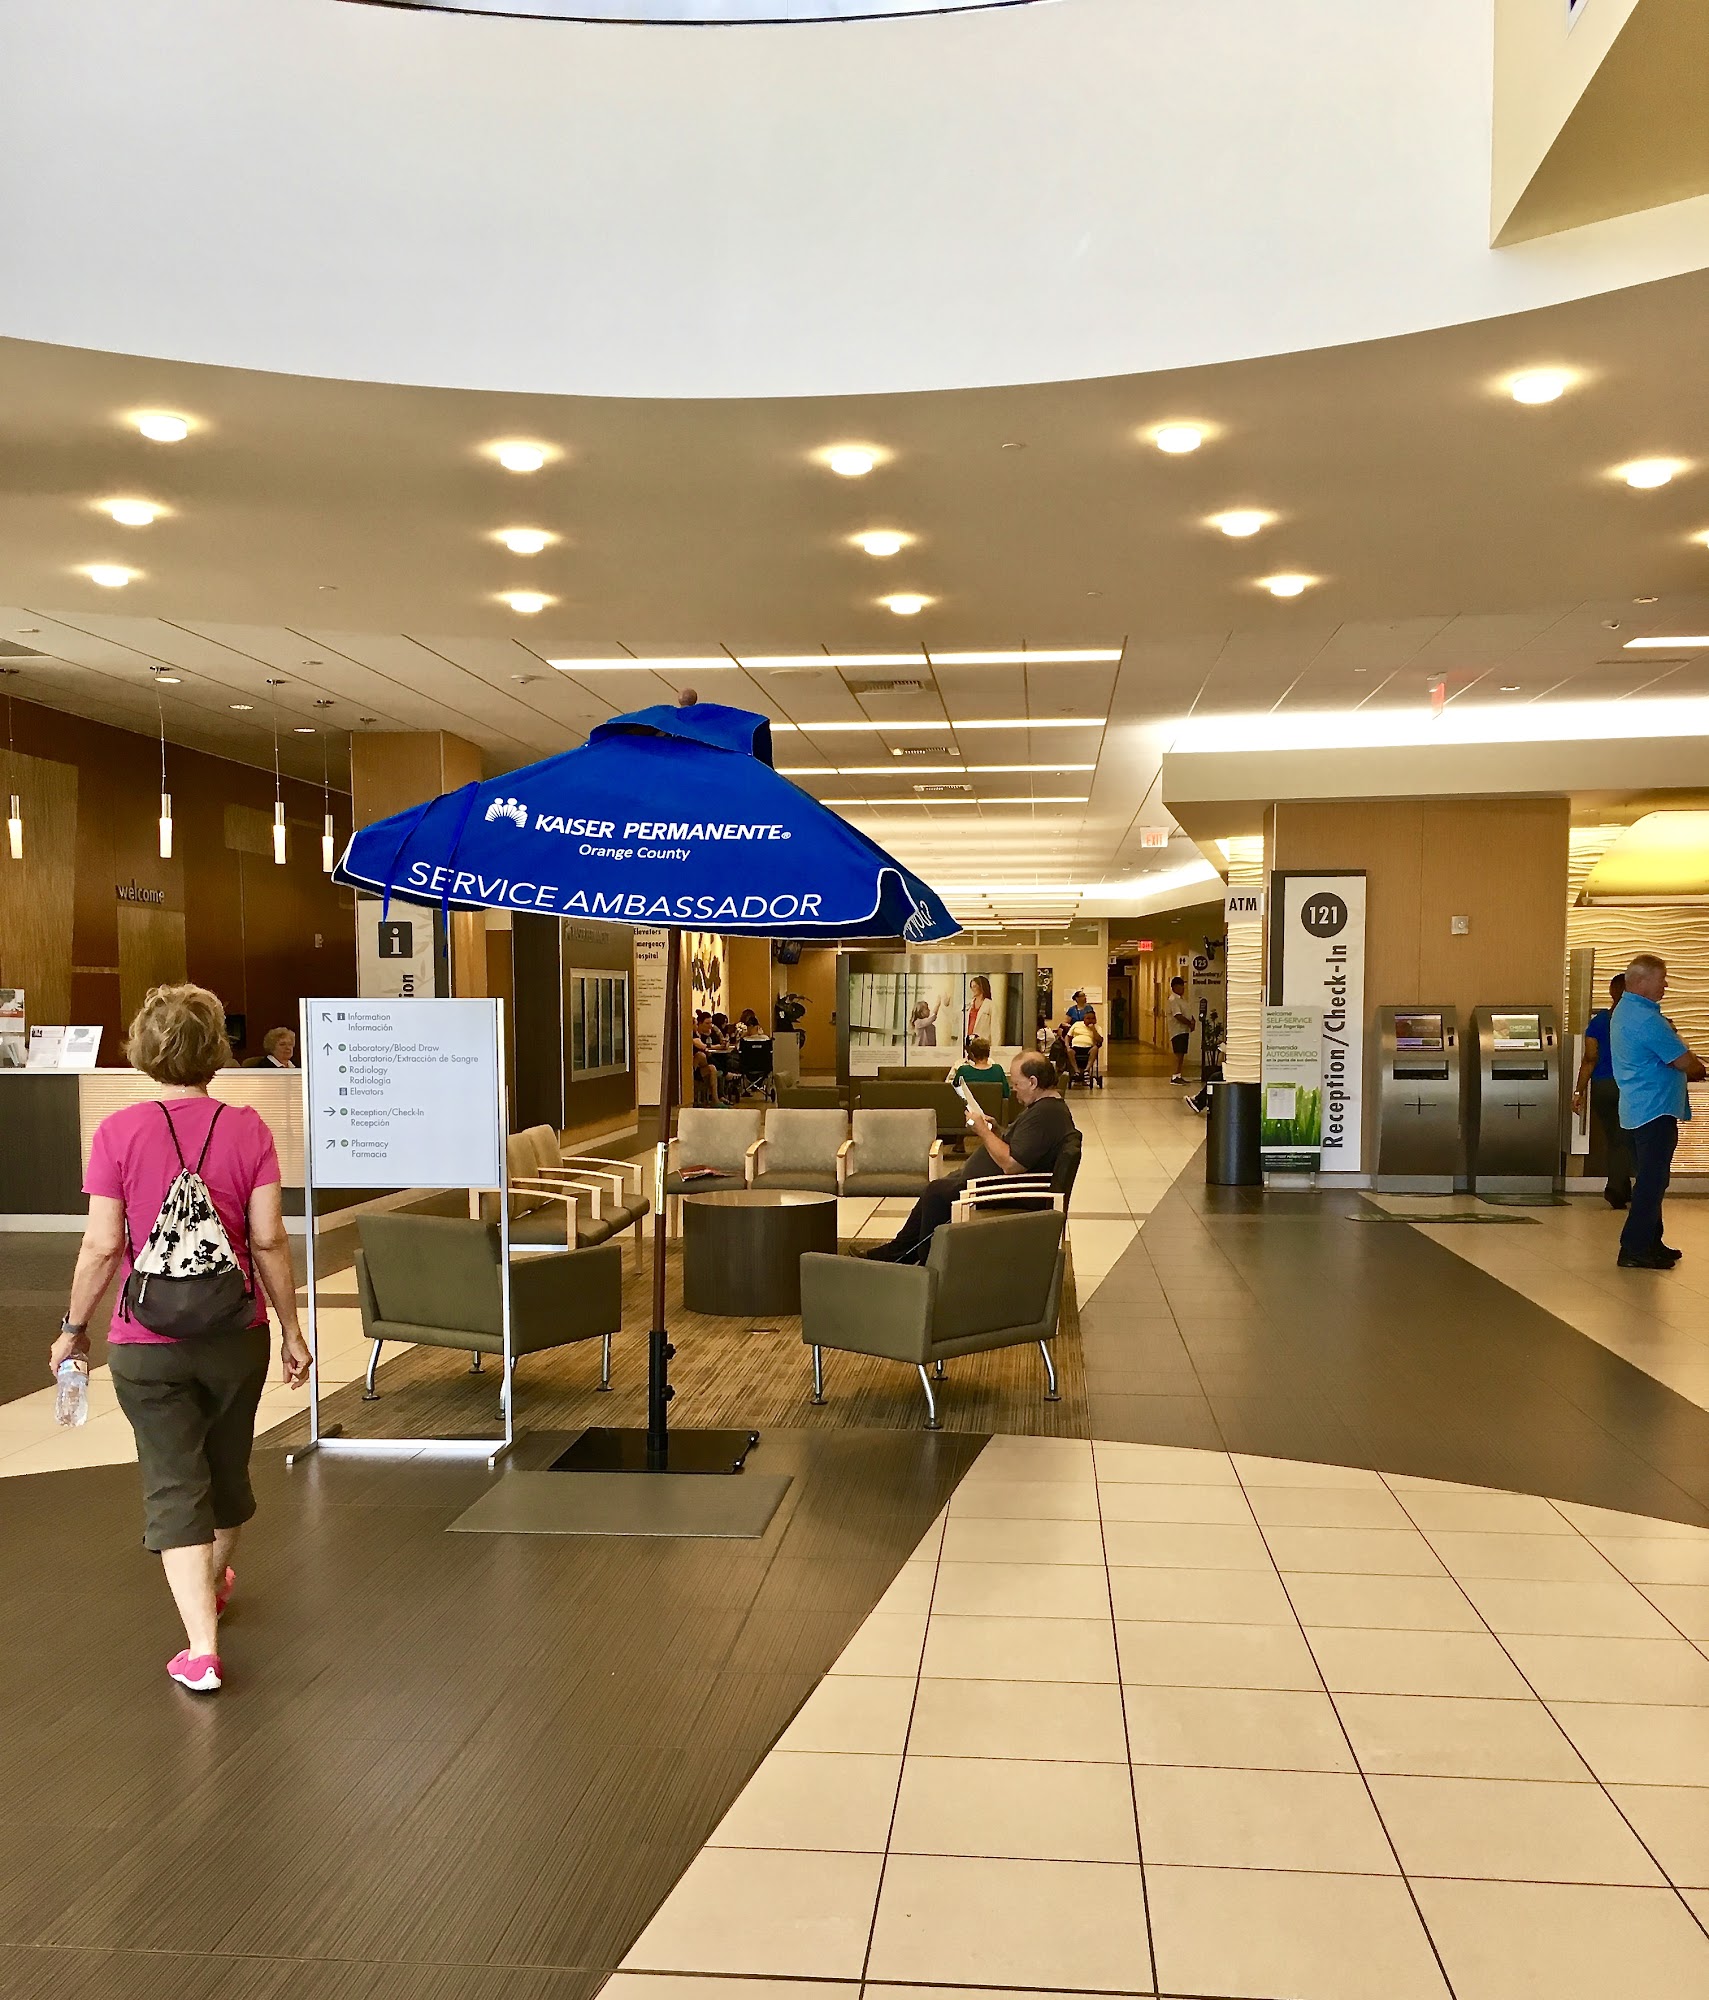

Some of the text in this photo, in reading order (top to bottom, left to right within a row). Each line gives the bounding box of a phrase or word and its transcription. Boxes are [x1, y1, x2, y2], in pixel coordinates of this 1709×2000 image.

[535, 814, 616, 839] KAISER
[1146, 831, 1163, 846] EXIT
[579, 844, 691, 861] Orange County
[116, 879, 165, 904] welcome
[407, 861, 822, 919] SERVICE AMBASSADOR
[1228, 897, 1258, 912] ATM
[1309, 905, 1339, 925] 121
[633, 927, 661, 936] Elevators
[636, 941, 666, 949] mergency
[347, 1012, 391, 1021] Information
[348, 1023, 393, 1032] Información
[348, 1043, 440, 1053] Laboratory/Blood Draw
[1322, 944, 1351, 1149] Reception/Check-In
[348, 1054, 479, 1065] Laboratorio/Extracción de Sangre
[349, 1065, 388, 1076] Radiology
[350, 1087, 384, 1096] Elevators
[350, 1107, 424, 1118] Reception/Check-In
[350, 1118, 390, 1128] Recepción
[351, 1139, 389, 1149] Pharmacy
[351, 1149, 387, 1158] Farmacia
